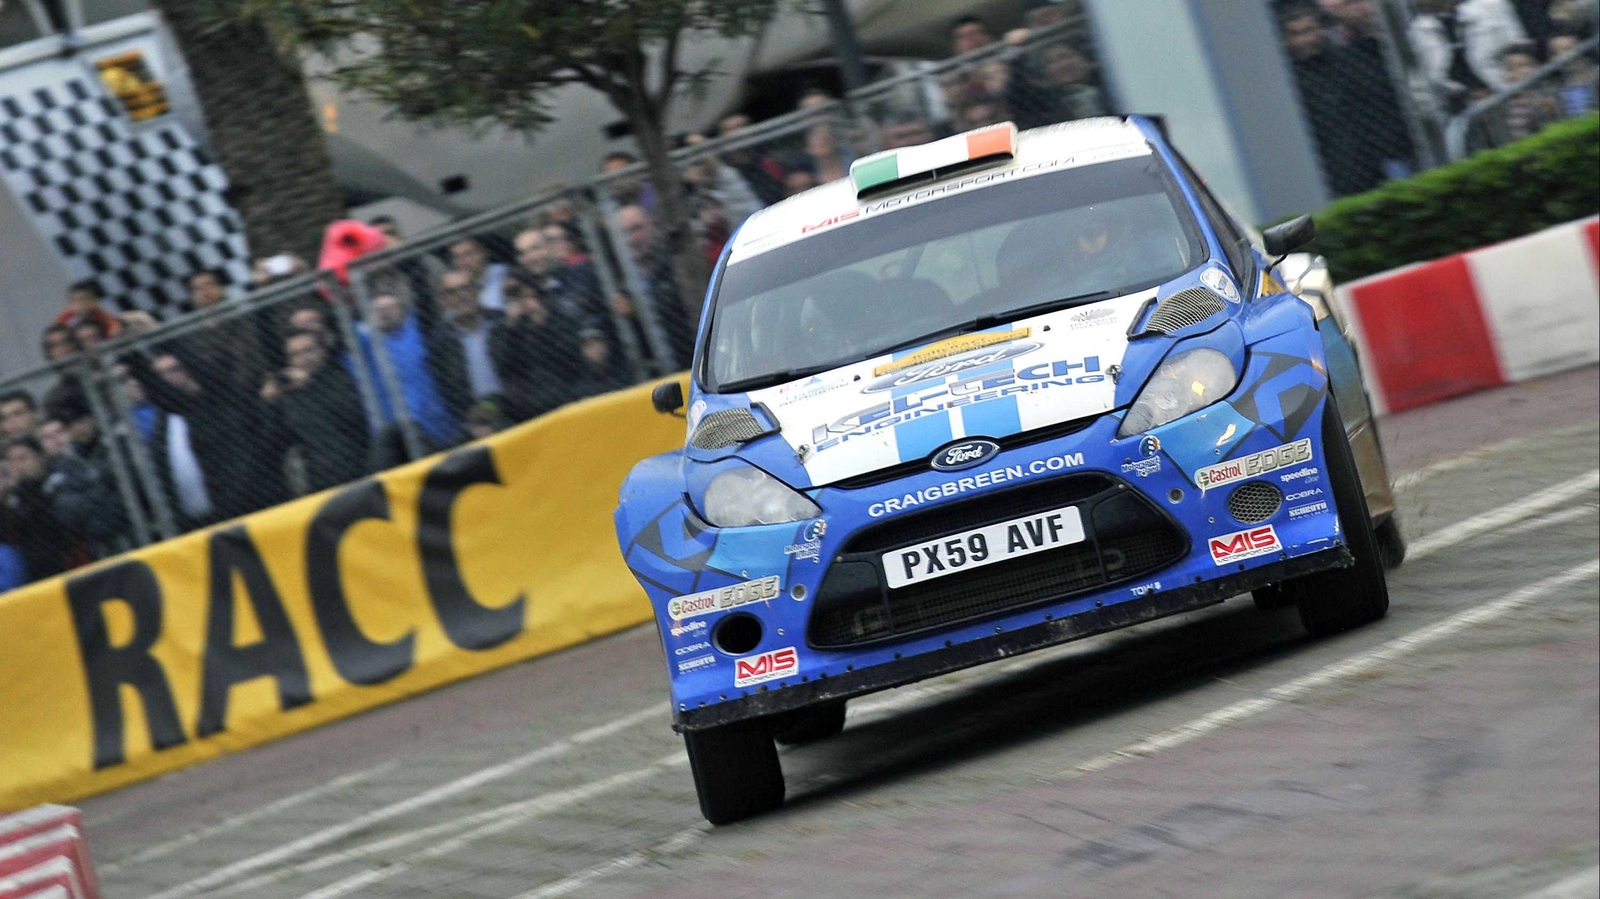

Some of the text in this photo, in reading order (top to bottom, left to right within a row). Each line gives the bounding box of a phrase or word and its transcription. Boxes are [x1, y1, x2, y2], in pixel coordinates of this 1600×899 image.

[894, 348, 1009, 386] Ford
[816, 374, 1105, 453] ENGINEERING
[945, 444, 983, 465] Ford
[1209, 439, 1311, 484] Castrol EDGE
[868, 452, 1085, 518] CRAIGBREEN.COM
[1286, 488, 1323, 501] COBRA
[902, 513, 1064, 579] PX59 AVF
[1210, 527, 1276, 559] MIS
[64, 446, 527, 770] RACC
[681, 576, 778, 614] Castrol EDGE
[737, 649, 795, 680] MIS
